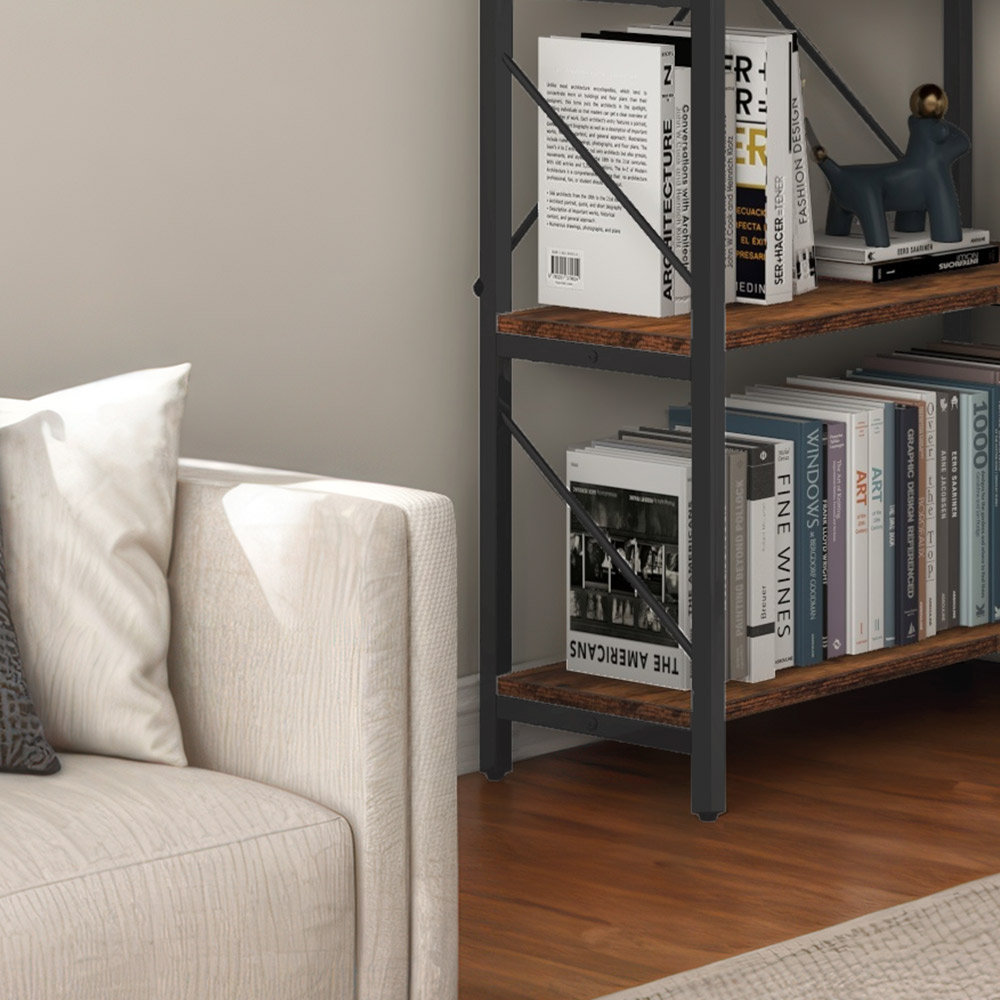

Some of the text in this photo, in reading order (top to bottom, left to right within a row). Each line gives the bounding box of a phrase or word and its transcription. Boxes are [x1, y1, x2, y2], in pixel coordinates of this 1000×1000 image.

[726, 136, 734, 155] Klotz
[791, 97, 808, 225] FASHION DESIGN
[726, 158, 734, 191] Heinrich
[726, 248, 734, 268] John
[939, 258, 978, 270] INTERIORS
[973, 401, 988, 469] 1000
[806, 429, 819, 529] WINDOWS
[856, 470, 867, 506] ART
[871, 467, 882, 502] ART
[735, 480, 744, 531] POLLOCK
[777, 474, 790, 535] FINE
[735, 535, 744, 579] BEYOND
[777, 546, 790, 639] WINES
[570, 640, 679, 675] THE AMERICANS
